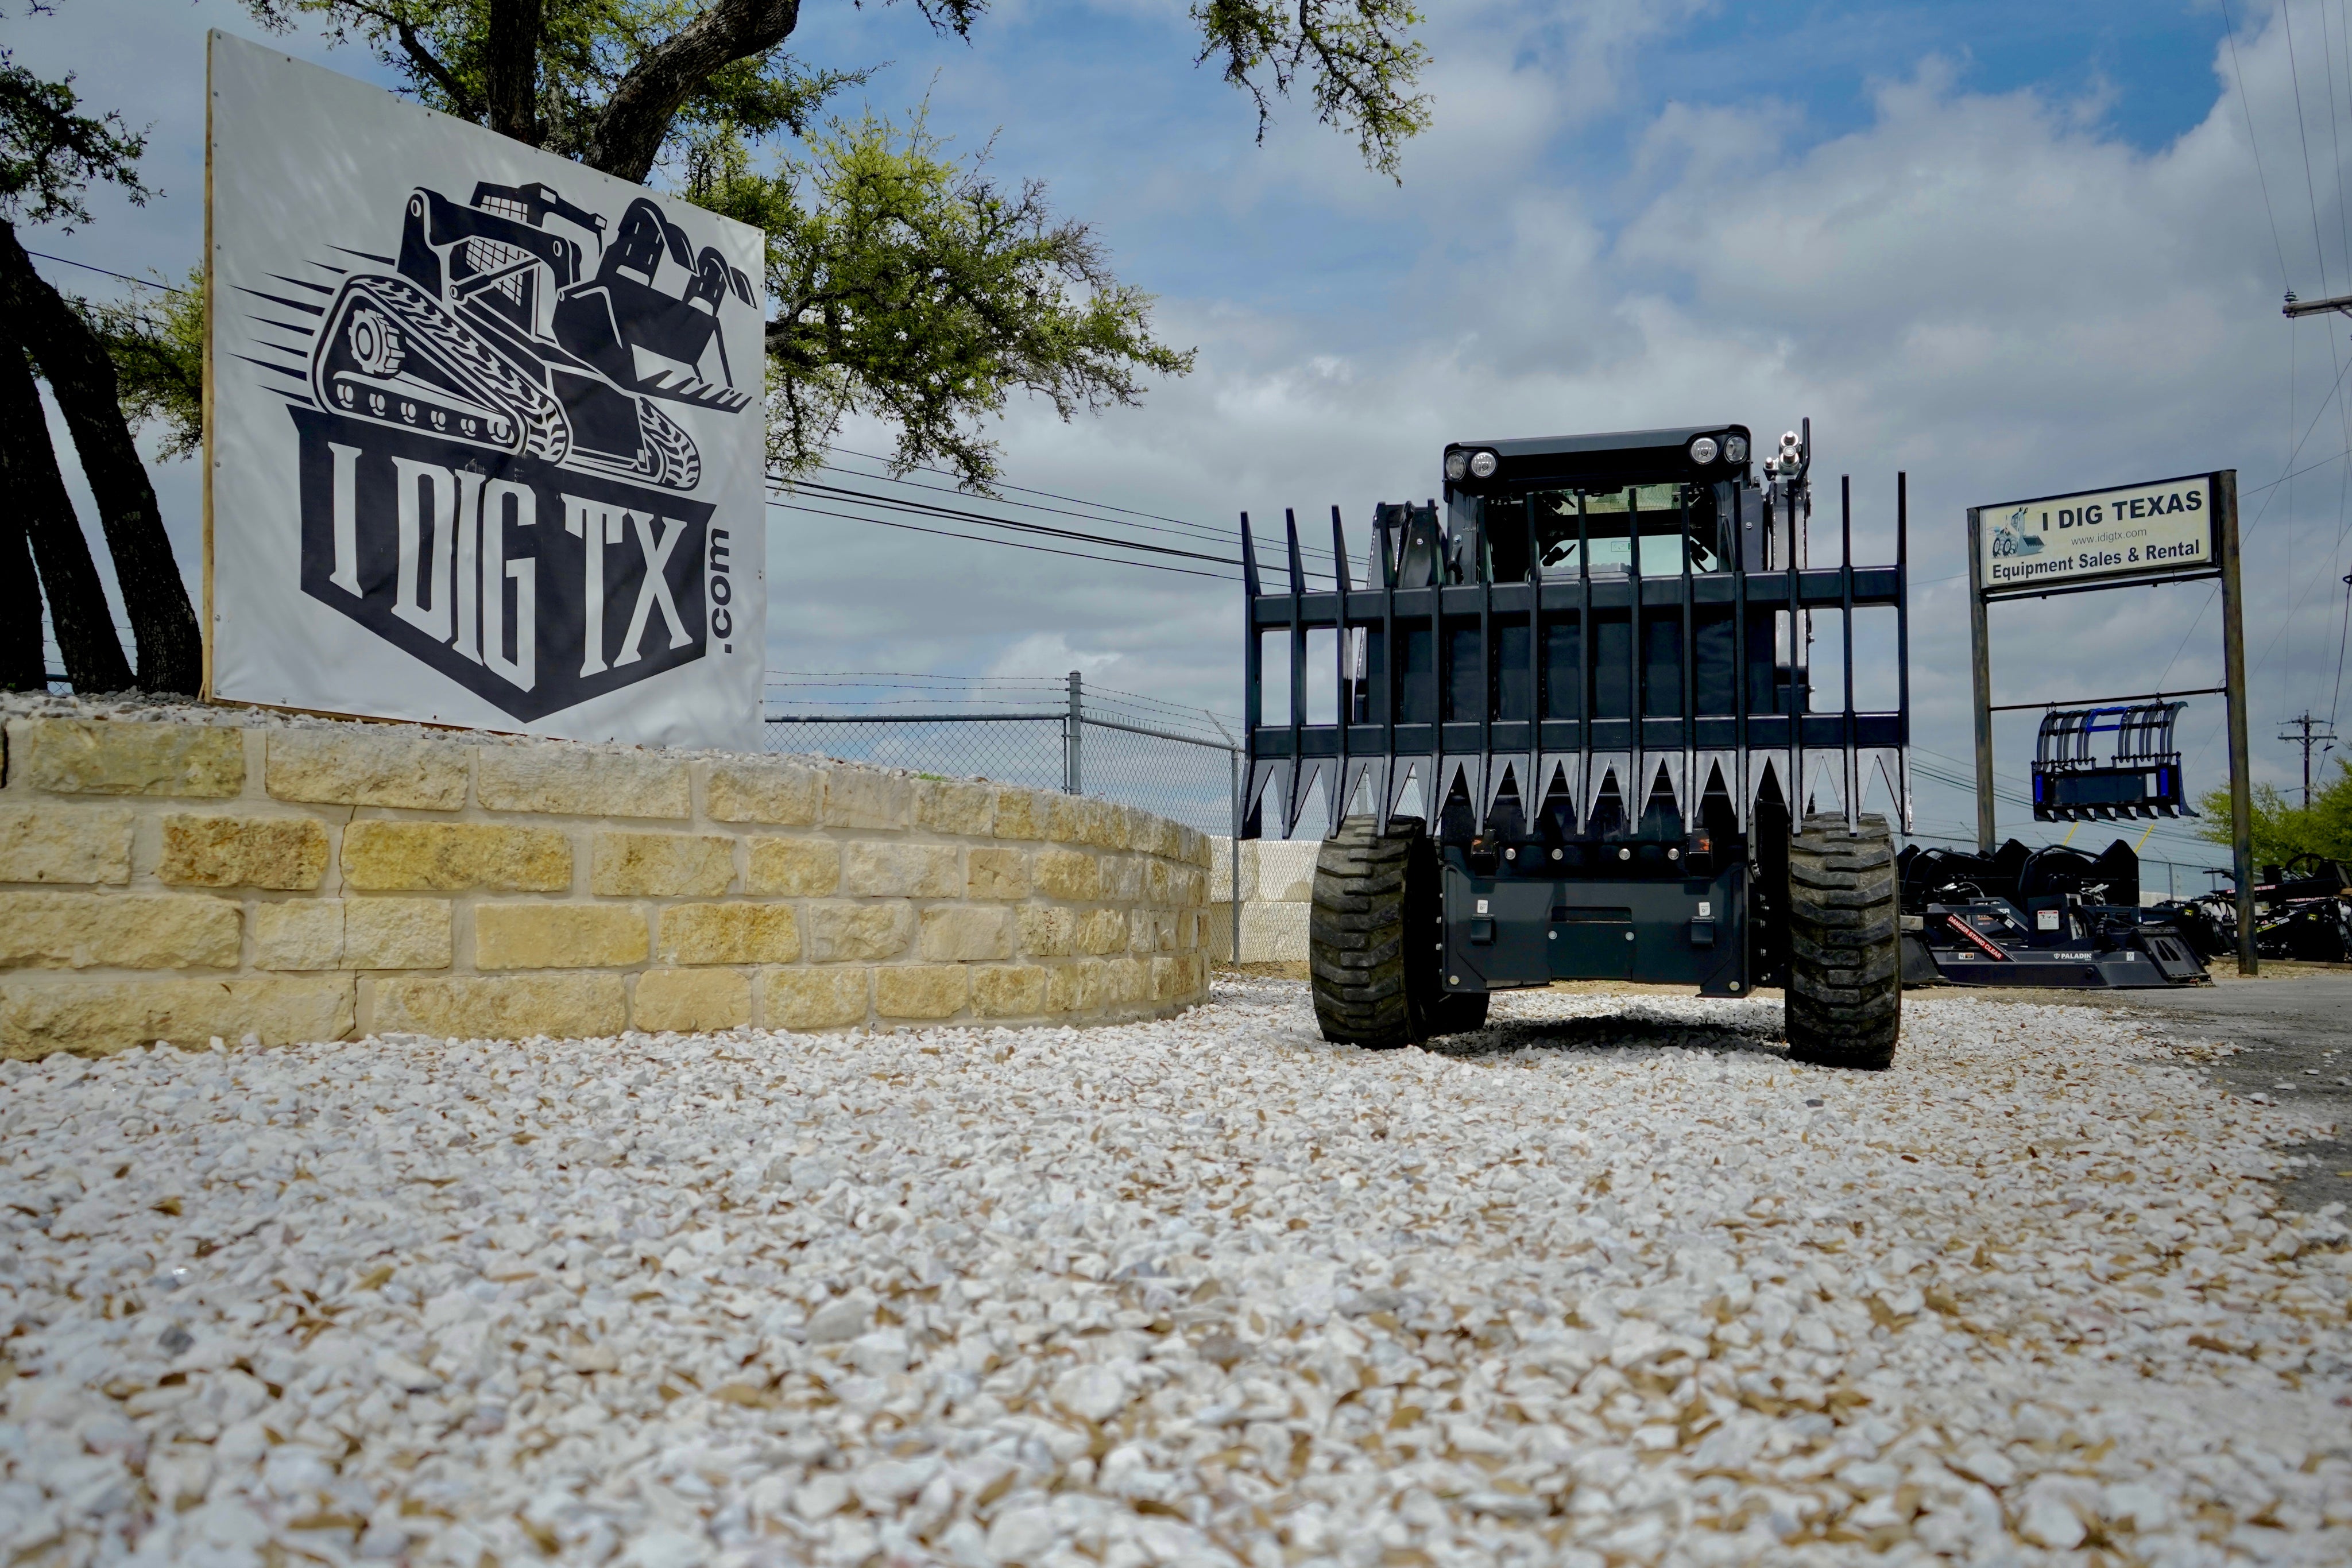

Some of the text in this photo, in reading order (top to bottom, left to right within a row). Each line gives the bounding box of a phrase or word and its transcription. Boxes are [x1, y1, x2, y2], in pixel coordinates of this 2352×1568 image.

[2042, 490, 2202, 531] I DIG TEXAS
[2071, 528, 2147, 546] www.idigtx.com
[328, 441, 693, 692] I DIG TX
[1993, 540, 2199, 580] Equipment Sales & Rental
[710, 528, 732, 654] .com
[1948, 916, 1968, 934] DANGER
[1968, 932, 1985, 946] STAND
[1984, 944, 2002, 959] CLEAR
